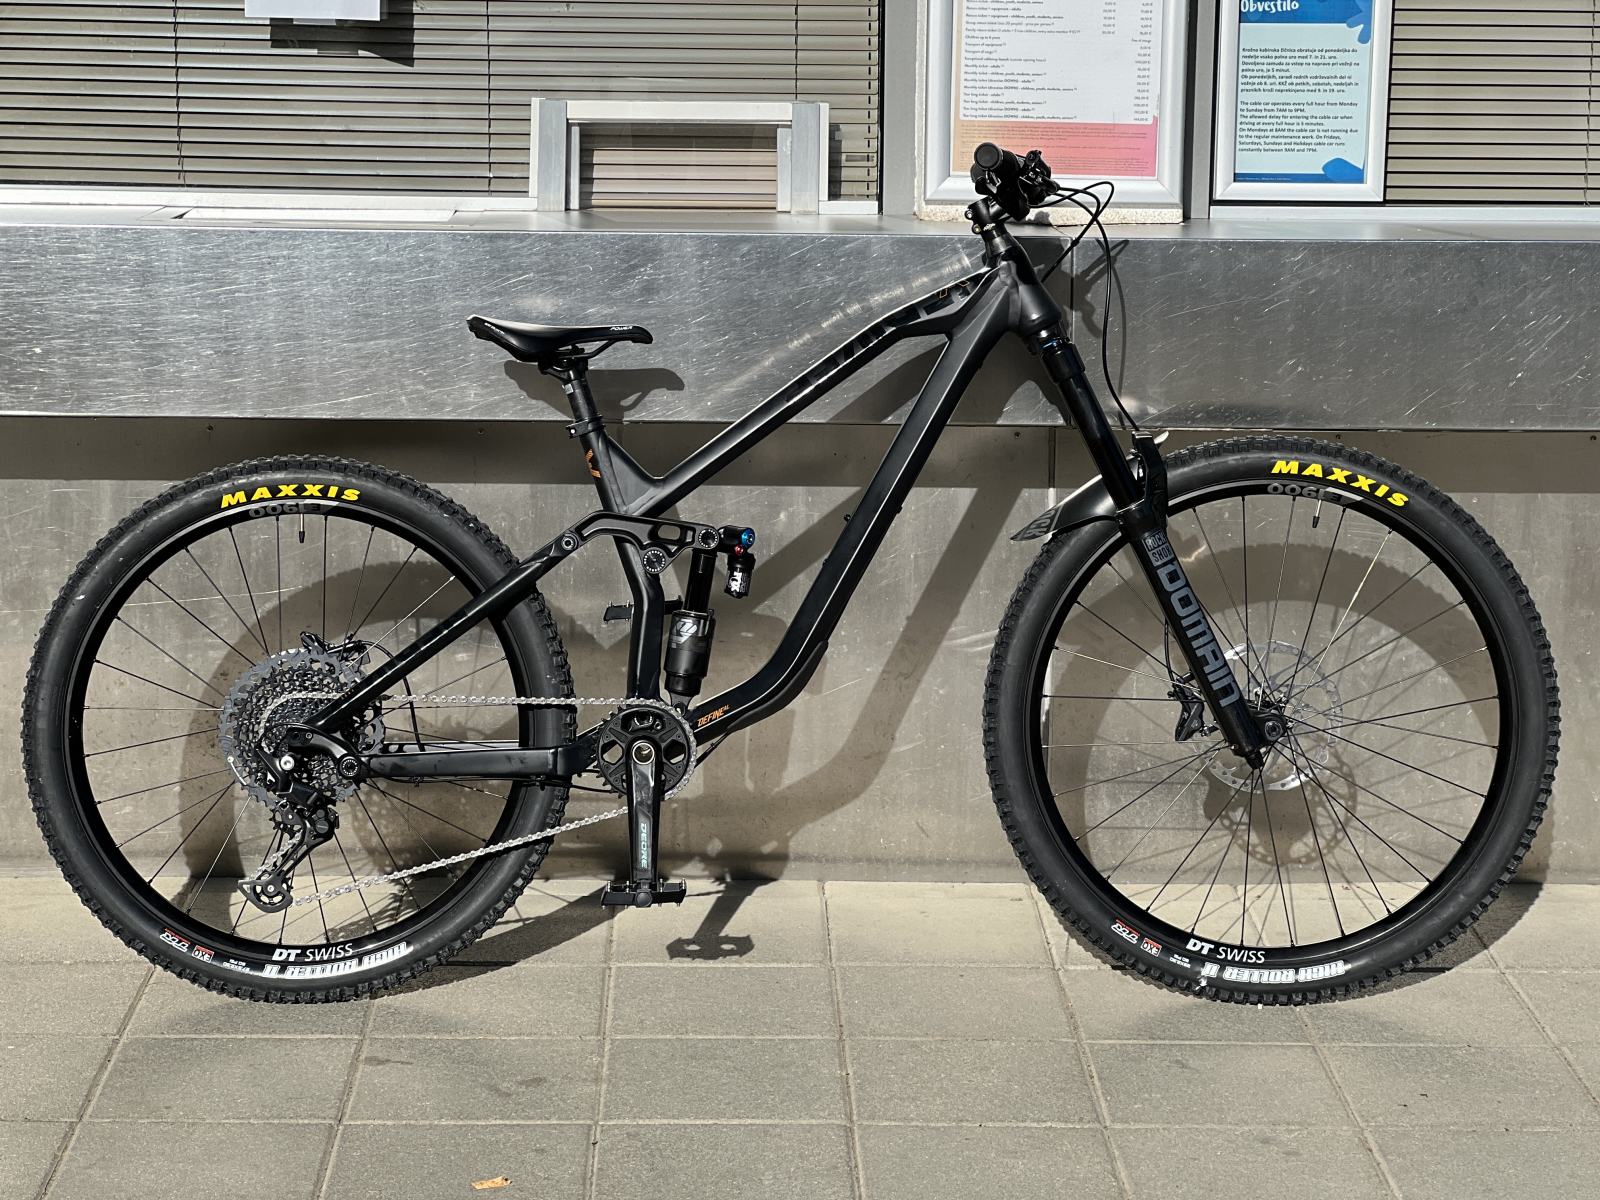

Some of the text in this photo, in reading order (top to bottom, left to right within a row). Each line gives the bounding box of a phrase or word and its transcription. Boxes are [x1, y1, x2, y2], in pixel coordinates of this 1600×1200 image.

[1240, 0, 1300, 13] Obvestilo
[1271, 460, 1409, 506] MAXXIS
[220, 484, 361, 508] MAXXIS
[1146, 532, 1167, 549] ROCK
[1152, 546, 1172, 563] SHOX
[728, 571, 742, 593] FOX
[1157, 559, 1240, 707] DOMAIN
[193, 949, 214, 962] EXO
[272, 943, 353, 961] DT SWISS
[1143, 942, 1161, 956] EXO
[1186, 938, 1266, 964] DT SWISS
[284, 958, 358, 978] ROLLER
[1223, 967, 1296, 983] ROLLER
[1297, 960, 1345, 982] HIGH
